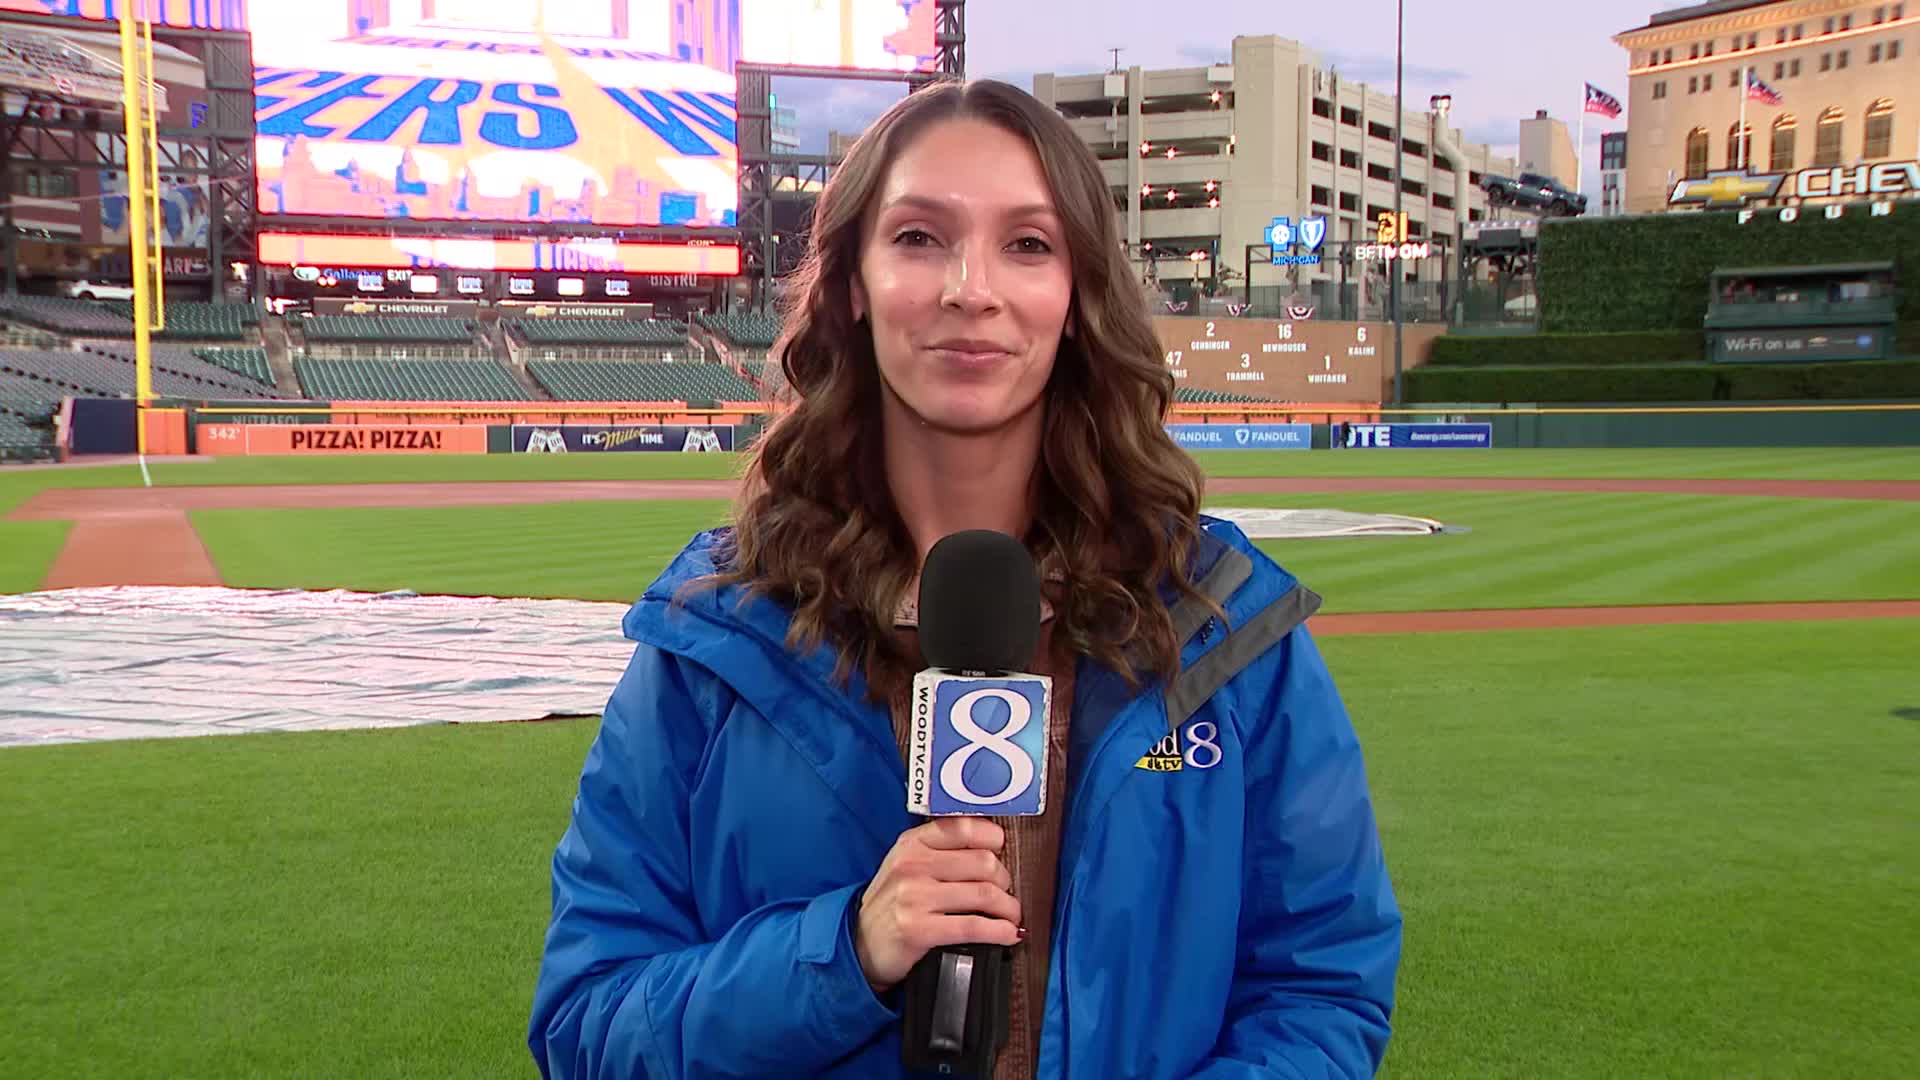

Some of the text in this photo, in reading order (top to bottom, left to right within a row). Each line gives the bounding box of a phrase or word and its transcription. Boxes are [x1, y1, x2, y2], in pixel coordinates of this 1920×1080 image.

[379, 303, 449, 314] CHEVROLET
[559, 306, 625, 317] CHEVROLET
[1206, 322, 1215, 337] 2
[1278, 324, 1292, 339] 16
[1357, 327, 1366, 342] 6
[1725, 337, 1803, 350] Wi-Fi on us
[1165, 351, 1183, 366] 47
[1240, 353, 1251, 369] 3
[1324, 355, 1331, 370] 1
[291, 430, 442, 449] PIZZA! PIZZA!
[582, 428, 664, 450] IT'S Miller TIME
[1251, 431, 1300, 442] FANDUEL
[914, 687, 929, 805] WOODTV.COM
[940, 688, 1034, 805] 8
[1184, 721, 1222, 768] 8
